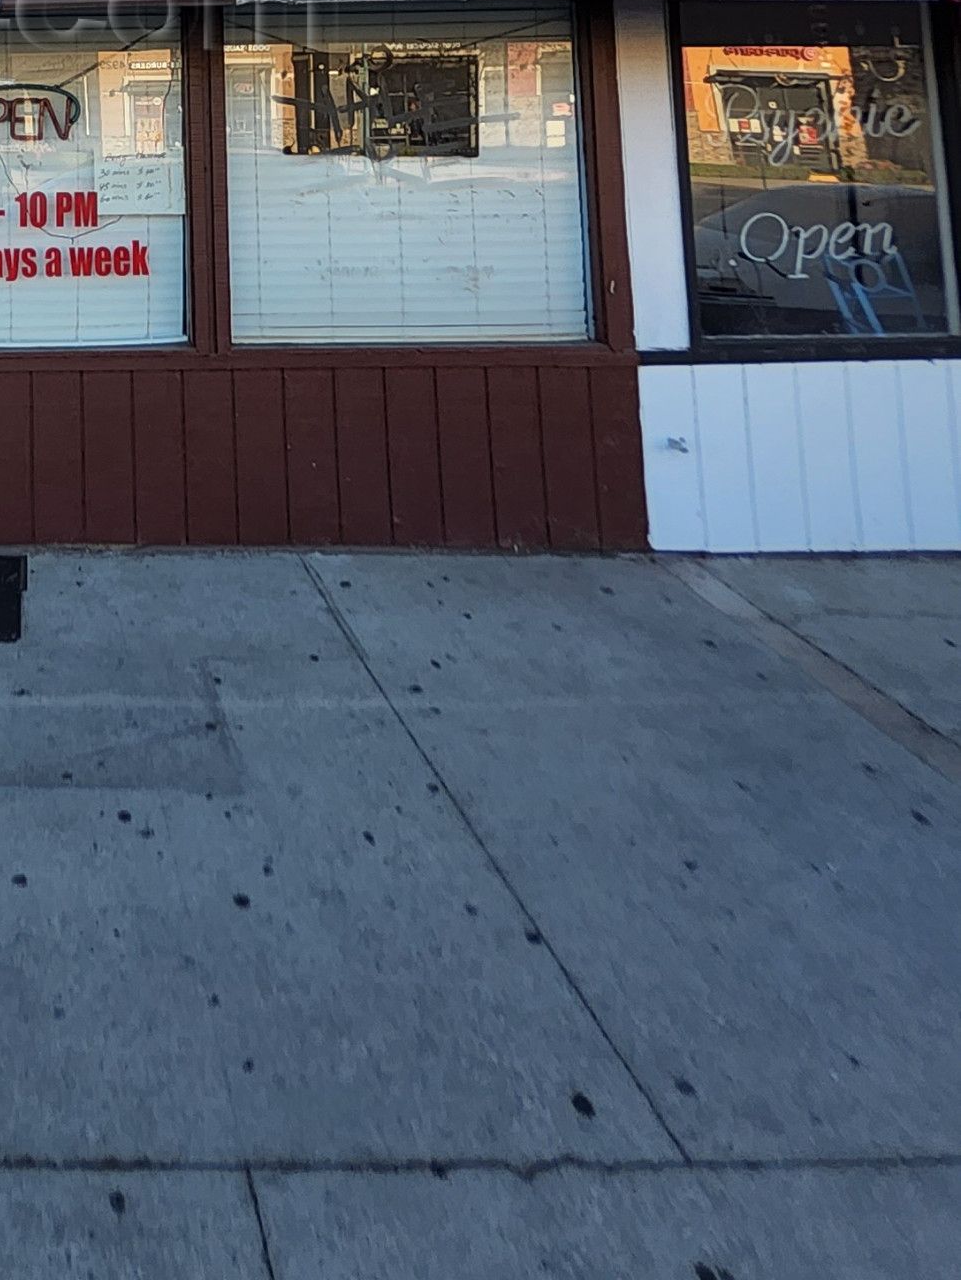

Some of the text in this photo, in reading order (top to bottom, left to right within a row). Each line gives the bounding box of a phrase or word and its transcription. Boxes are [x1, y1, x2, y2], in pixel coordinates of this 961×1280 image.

[15, 191, 47, 228] 10
[56, 190, 98, 227] PM
[45, 246, 63, 278] a
[69, 239, 150, 277] week
[741, 213, 897, 279] Open
